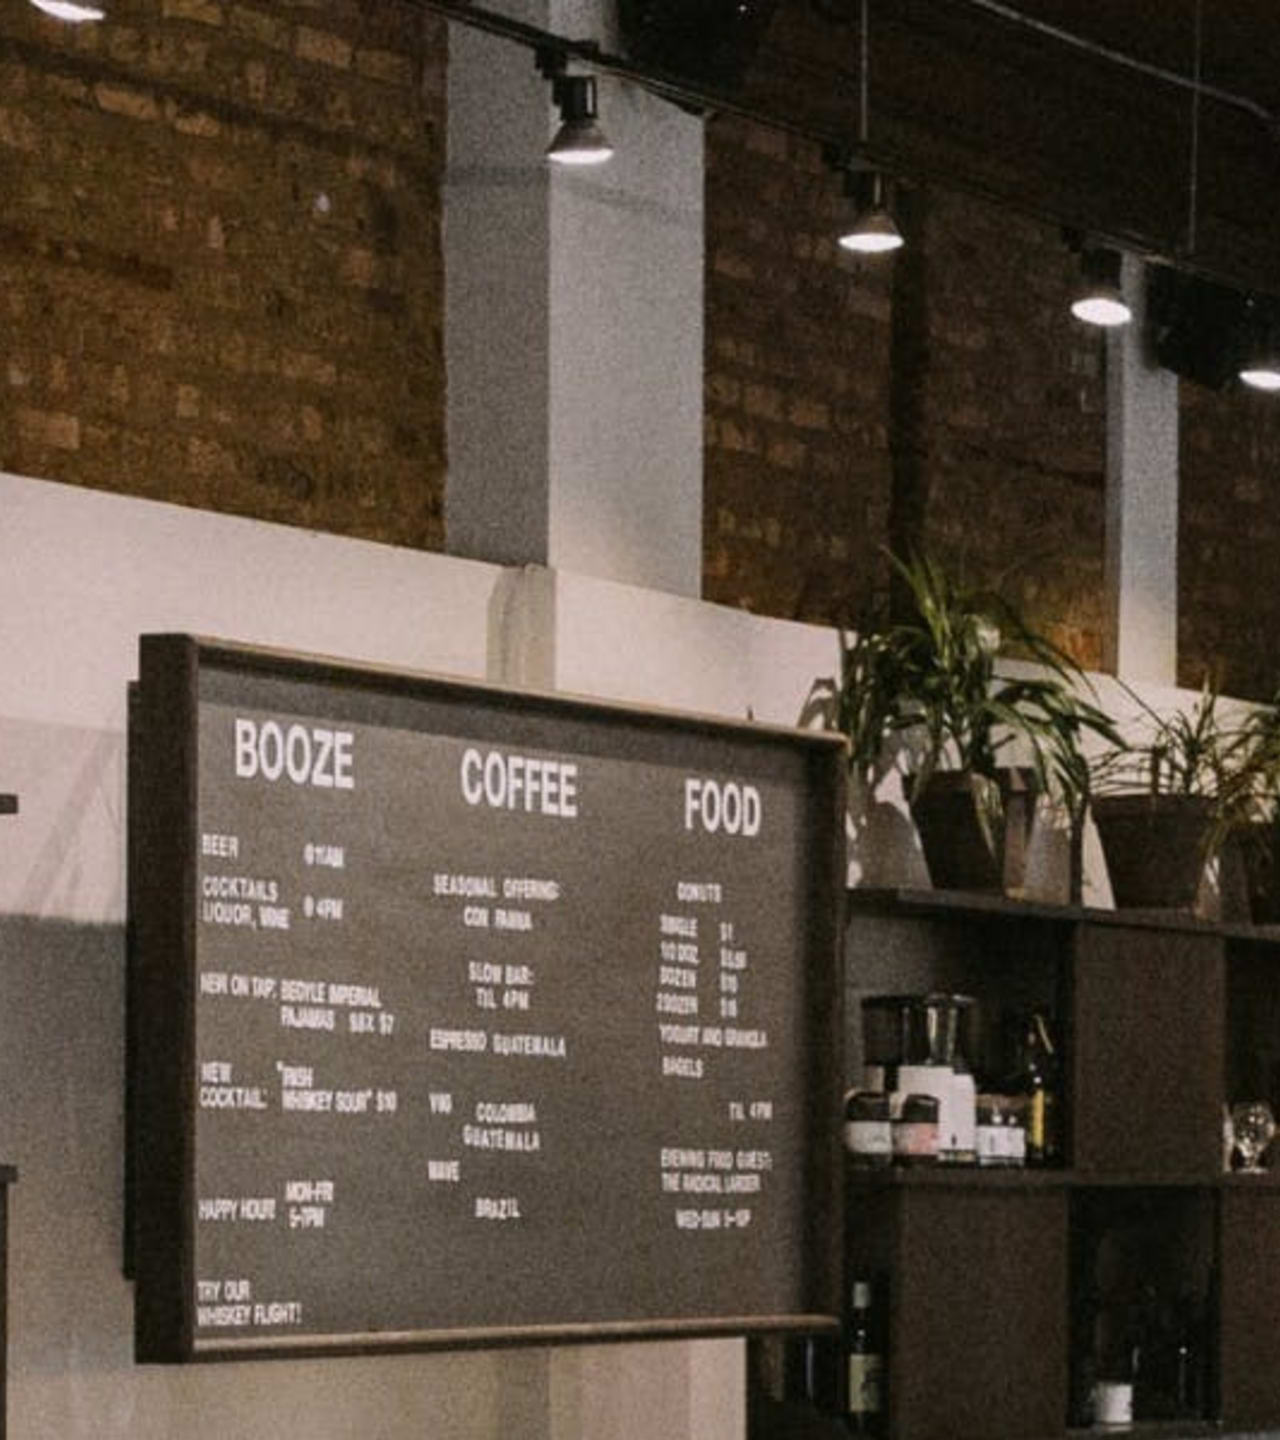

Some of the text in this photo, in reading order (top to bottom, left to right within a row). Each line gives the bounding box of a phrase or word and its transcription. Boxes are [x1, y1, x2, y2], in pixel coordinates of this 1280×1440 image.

[235, 718, 354, 789] BOOZE
[461, 749, 577, 818] COFFEE
[685, 778, 761, 837] FOOD
[202, 833, 238, 858] BEER
[202, 875, 278, 903] COCKTAILS
[433, 874, 498, 899] SEASONAL
[200, 971, 228, 995] NEW
[231, 974, 249, 996] ON
[469, 961, 502, 984] SLOW
[430, 1028, 567, 1057] ESPRESSO GUATEMALA
[201, 1061, 232, 1083] NEW
[662, 1056, 704, 1078] BAGELS
[462, 1123, 540, 1151] GUATEMALA
[661, 1172, 680, 1192] THE
[199, 1198, 237, 1221] HAPPY
[475, 1198, 521, 1220] BRAZIL
[224, 1280, 250, 1302] OUR
[198, 1305, 252, 1327] WHISKEY
